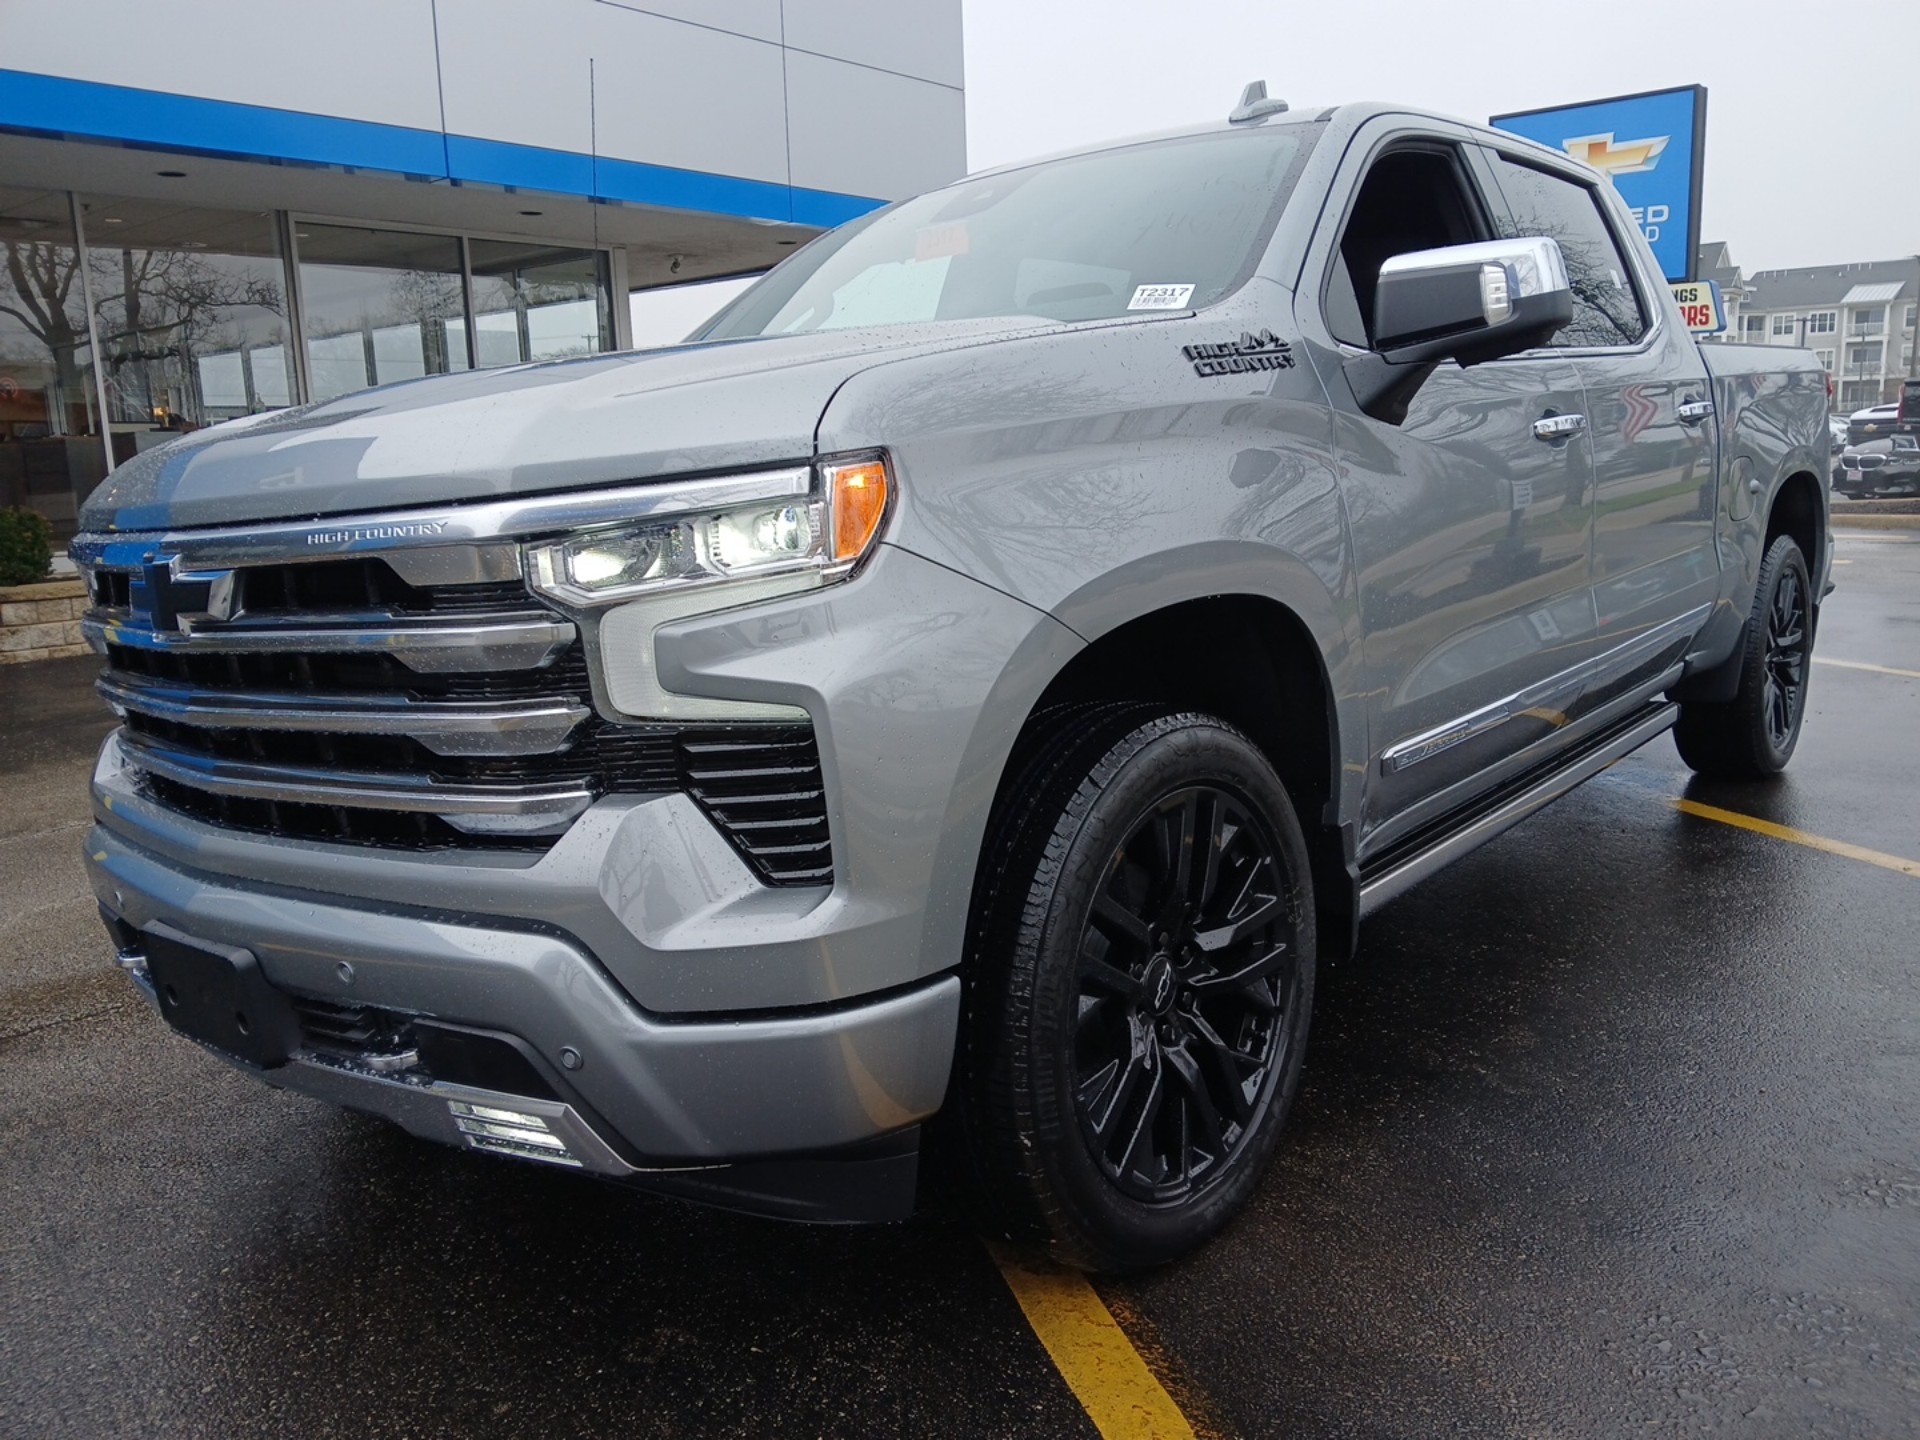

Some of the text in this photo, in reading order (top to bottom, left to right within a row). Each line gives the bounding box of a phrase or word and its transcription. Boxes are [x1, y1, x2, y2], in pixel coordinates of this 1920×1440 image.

[1139, 287, 1190, 297] T2317
[1182, 341, 1243, 362] HIGH
[1194, 354, 1296, 378] COUNTRY
[307, 521, 449, 545] HIGH COUNTRY
